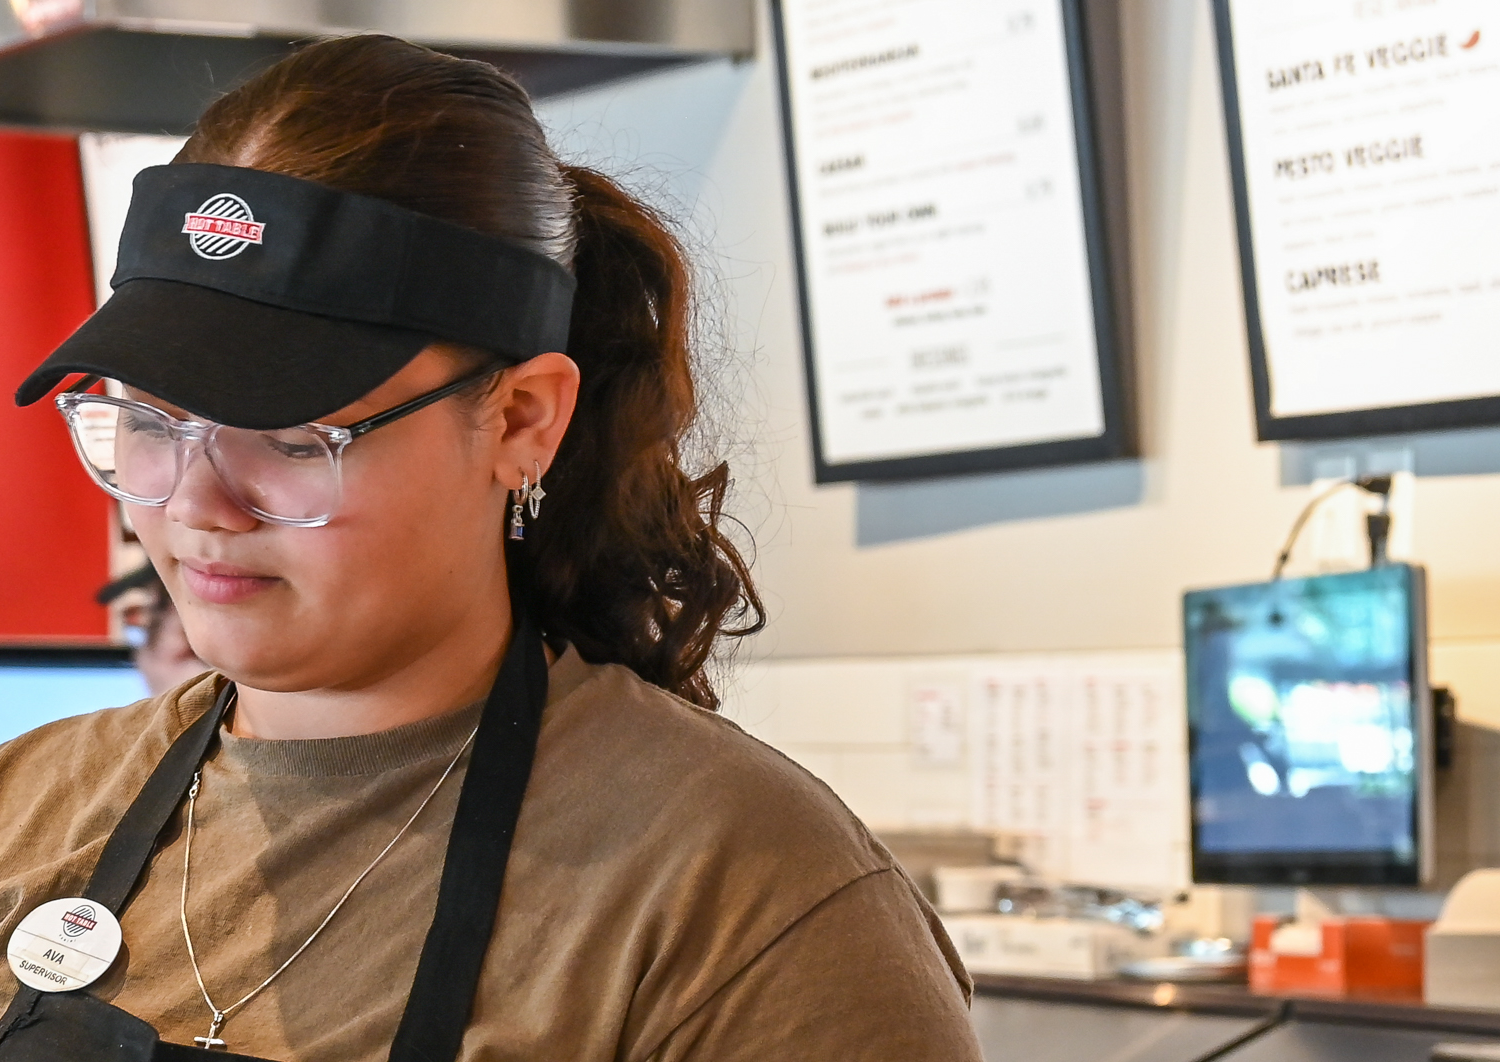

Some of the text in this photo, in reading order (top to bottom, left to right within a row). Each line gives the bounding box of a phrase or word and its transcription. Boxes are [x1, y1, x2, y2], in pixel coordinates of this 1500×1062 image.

[1266, 60, 1325, 91] SANTA
[1333, 52, 1356, 75] FE
[1364, 32, 1449, 68] VEGGIE
[1274, 133, 1424, 178] PESTO VEGGIE
[188, 217, 258, 239] HOT TABLE
[1286, 258, 1380, 293] CAPRESE
[63, 913, 96, 930] HOT TABLE
[43, 948, 65, 965] AVA
[19, 960, 68, 985] SUPERVISOR
